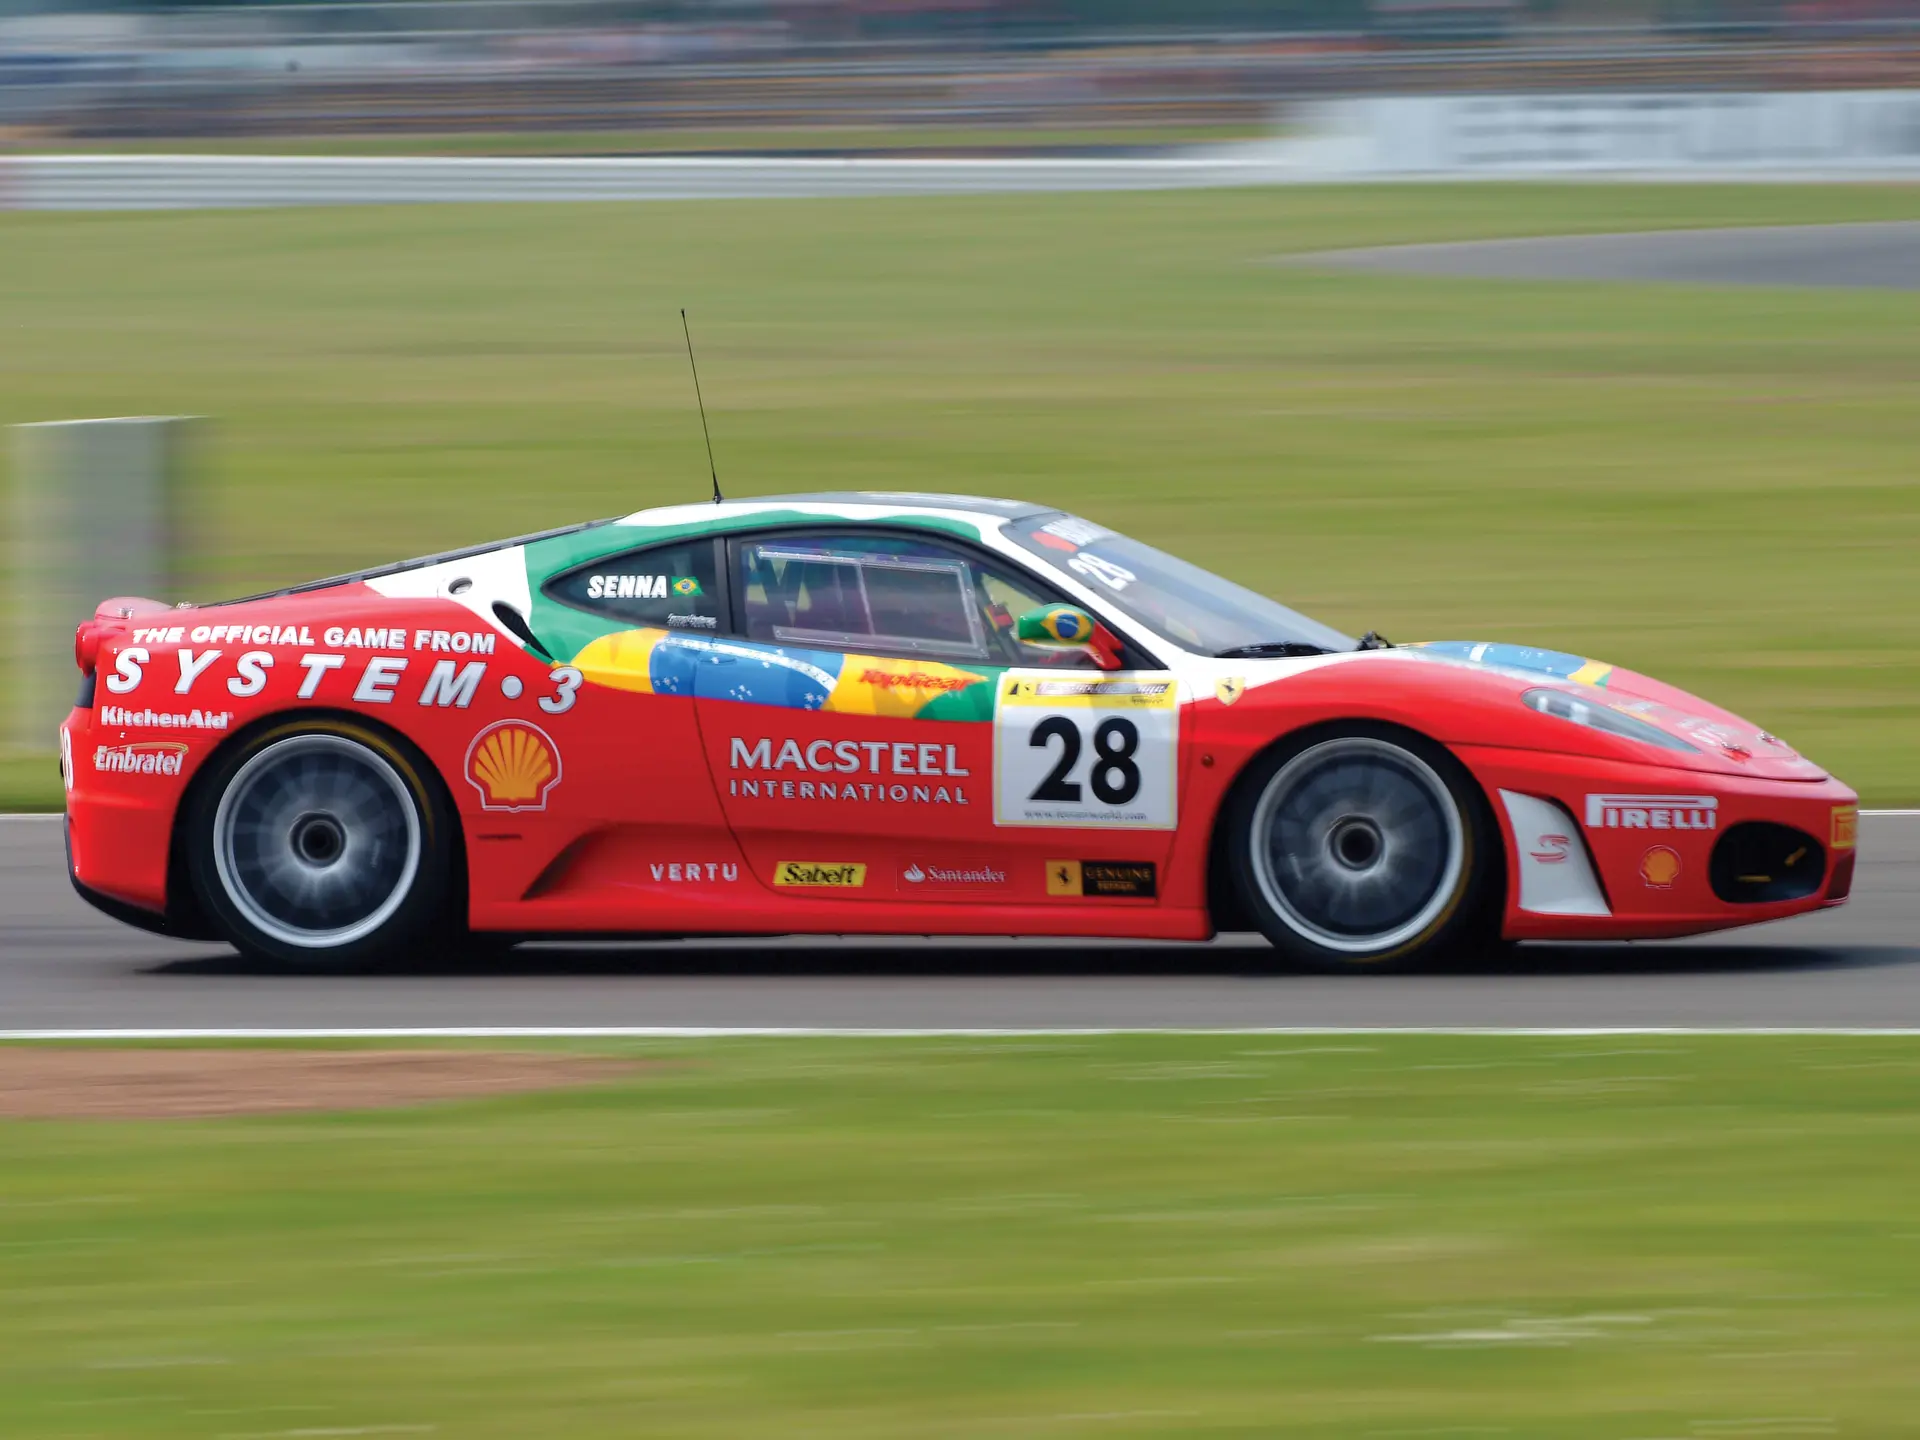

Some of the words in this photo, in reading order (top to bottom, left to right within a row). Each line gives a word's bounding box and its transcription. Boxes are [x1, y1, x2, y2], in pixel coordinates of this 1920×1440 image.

[587, 575, 667, 598] SENNA
[132, 627, 185, 644] THE
[190, 625, 315, 645] OFFICIAL
[323, 627, 407, 649] GAME
[413, 629, 496, 655] FROM
[95, 745, 184, 776] Embratel
[729, 737, 970, 777] MACSTEEL
[1028, 715, 1142, 806] 28
[729, 779, 969, 805] INTERNATIONAL
[1586, 793, 1718, 830] PIRELLI
[650, 863, 738, 881] VERTU
[783, 863, 856, 884] Sabelt
[928, 866, 1005, 883] Santander
